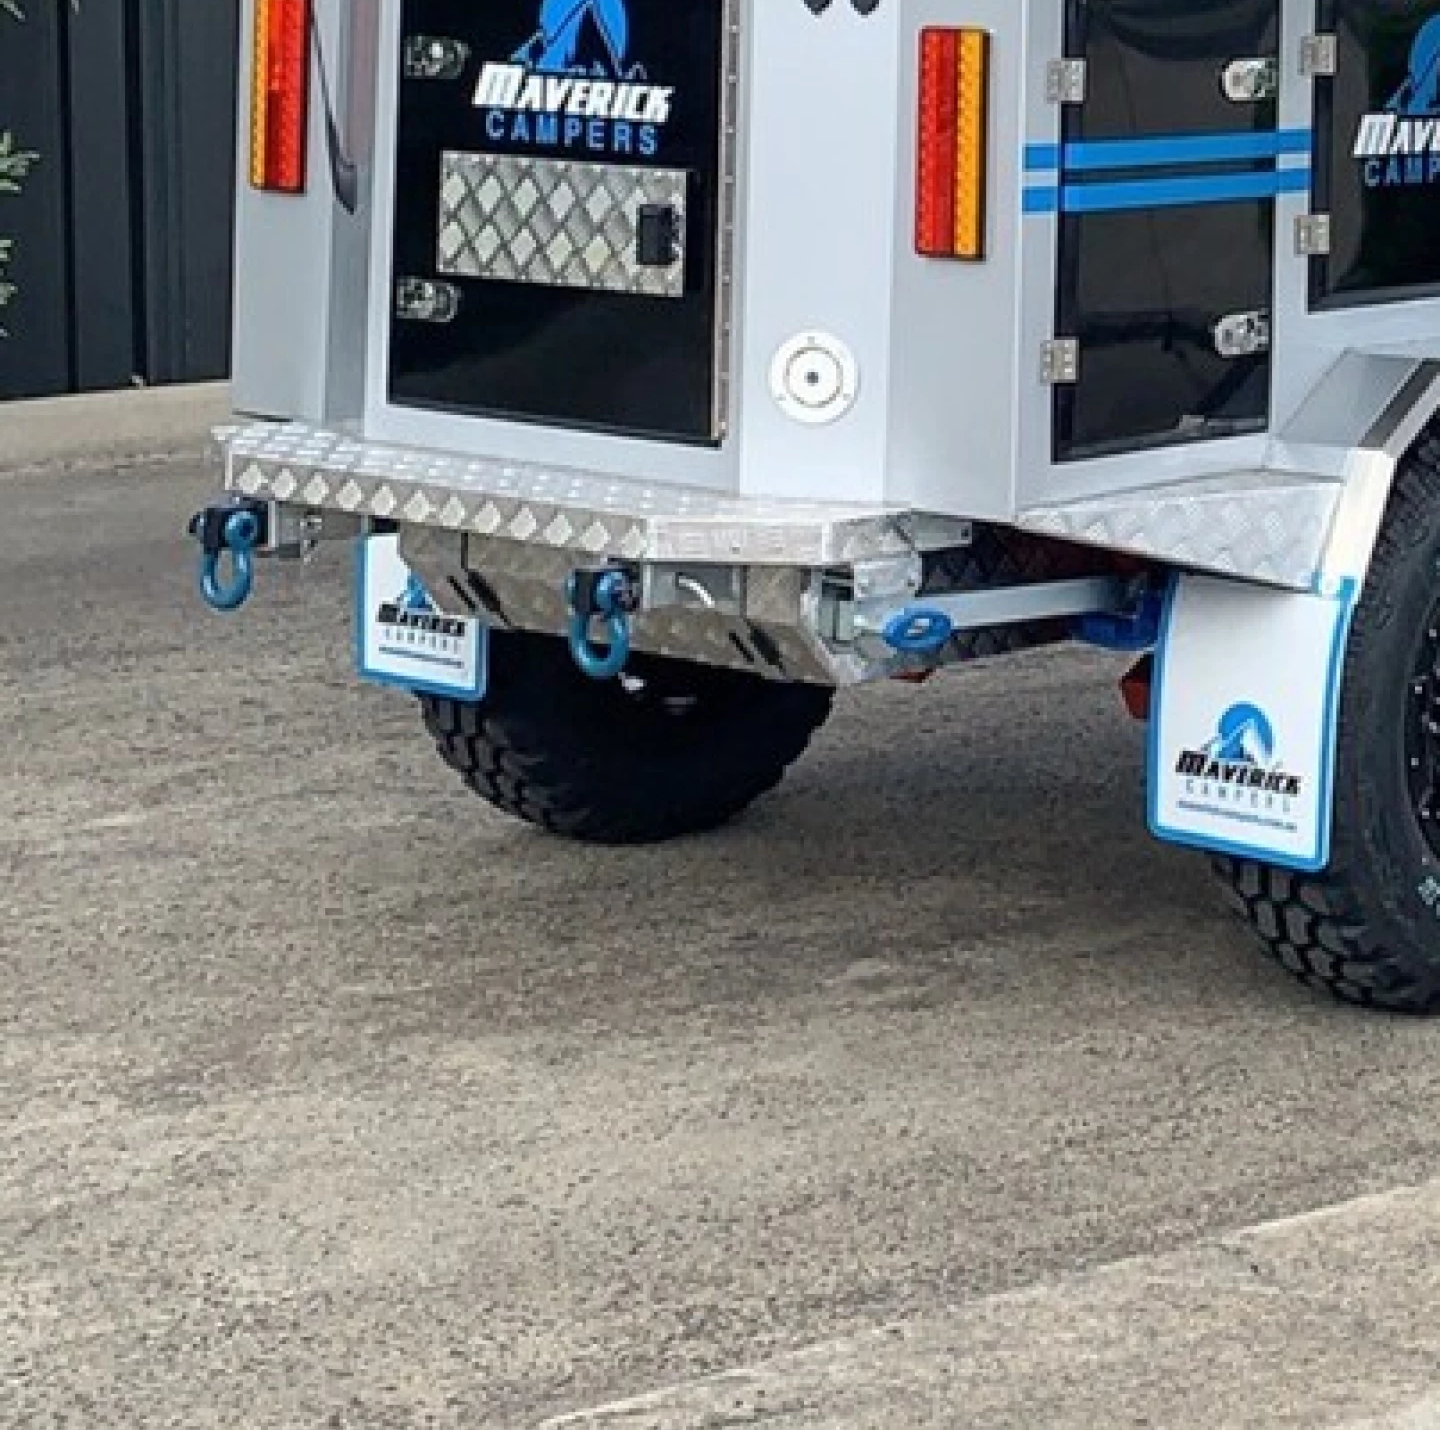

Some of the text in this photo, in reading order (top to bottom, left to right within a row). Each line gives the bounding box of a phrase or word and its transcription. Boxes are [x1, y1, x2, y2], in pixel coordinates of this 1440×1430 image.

[472, 61, 675, 123] MAVERICK
[485, 110, 658, 155] CAMPERS
[1174, 750, 1301, 797] MAVERICK
